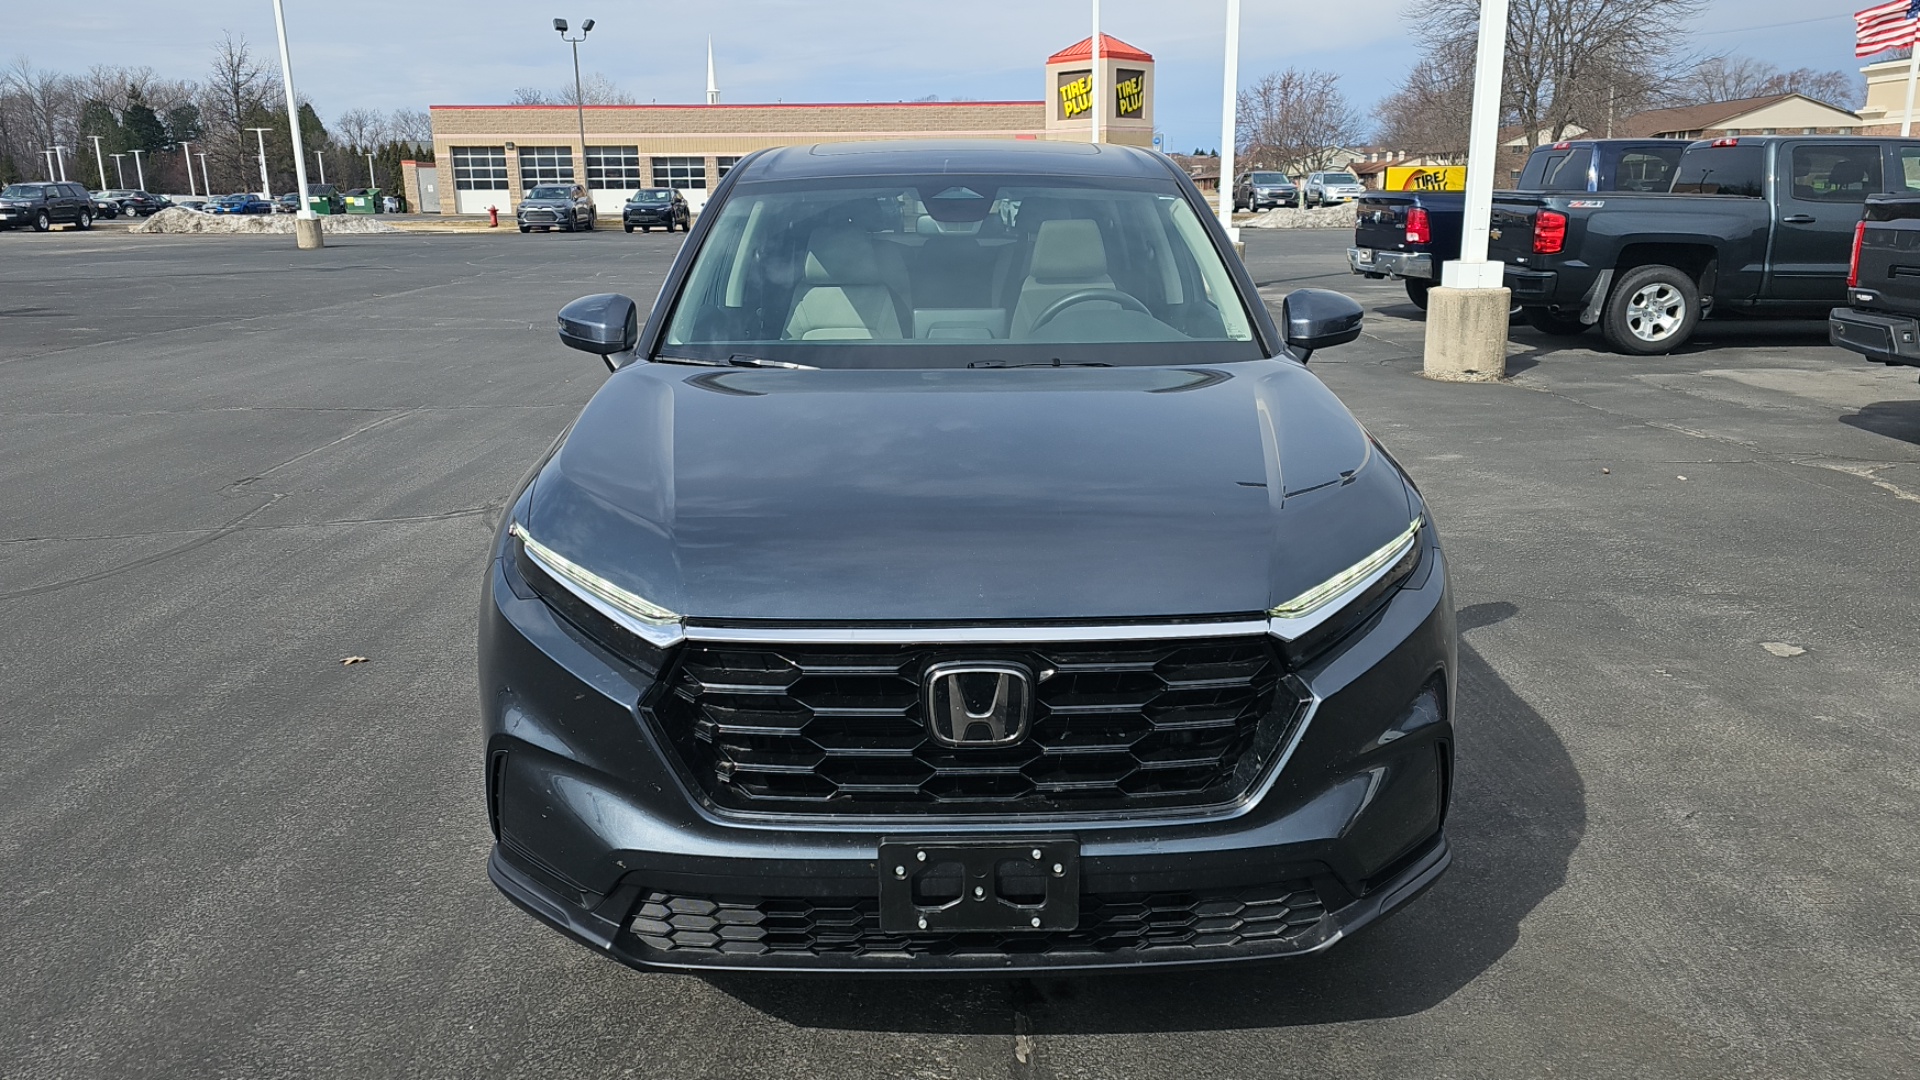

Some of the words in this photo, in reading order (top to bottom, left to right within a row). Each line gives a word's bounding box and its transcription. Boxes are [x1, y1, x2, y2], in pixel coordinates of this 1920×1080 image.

[1060, 74, 1093, 101] TIRES
[1116, 75, 1142, 99] TIRES
[1119, 92, 1143, 115] PLUS
[1414, 169, 1447, 189] TIRES
